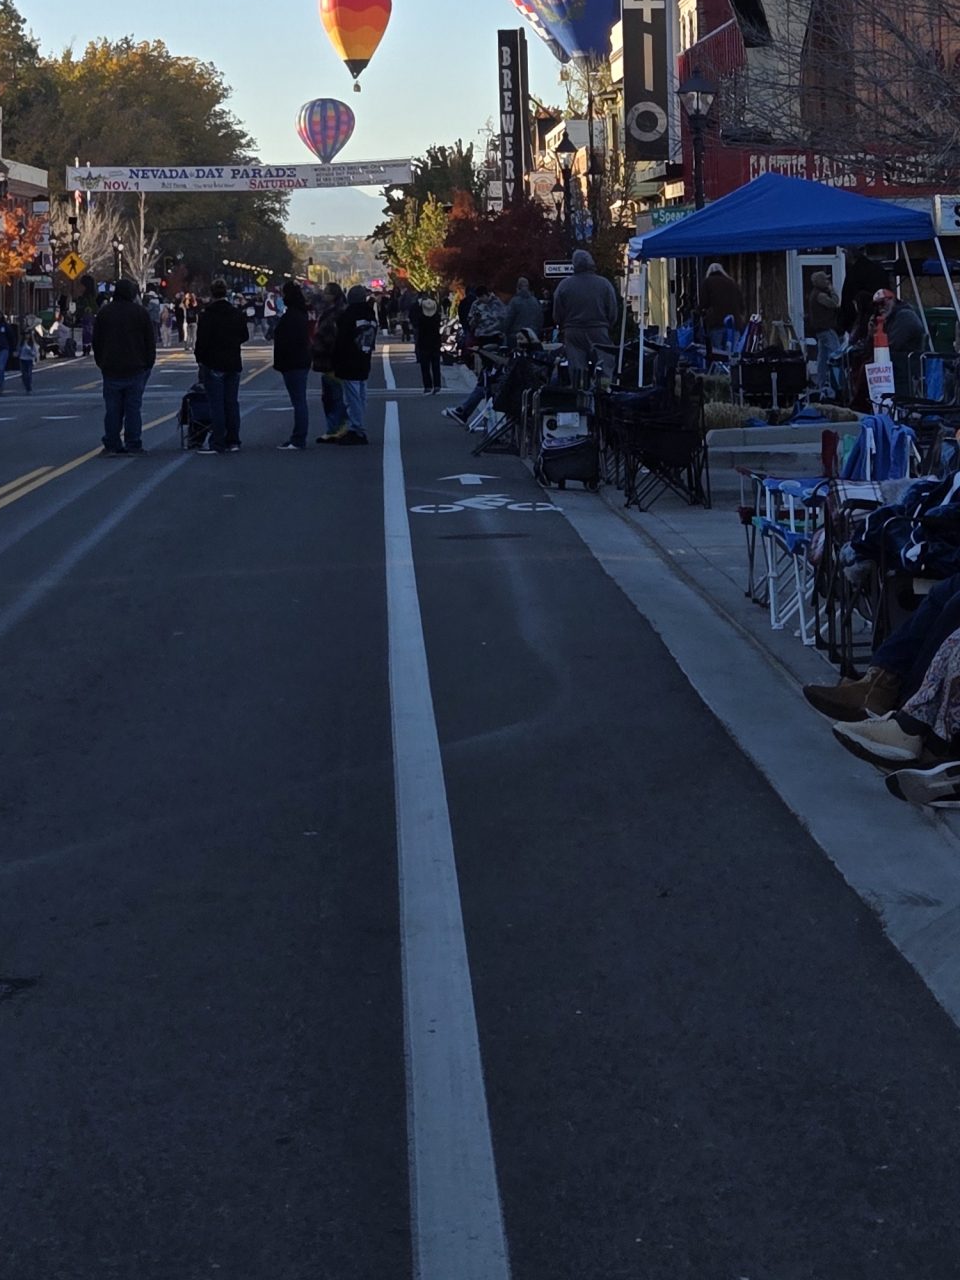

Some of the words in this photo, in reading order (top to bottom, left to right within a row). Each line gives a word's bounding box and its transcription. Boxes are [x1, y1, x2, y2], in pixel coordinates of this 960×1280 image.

[501, 46, 516, 202] BREWERY
[129, 169, 189, 179] NEVADA
[194, 168, 224, 179] DAY
[231, 167, 297, 179] PARADE
[103, 181, 131, 190] NOV.
[134, 181, 140, 190] 1
[249, 178, 309, 190] SATURDAY
[659, 209, 685, 224] Spear
